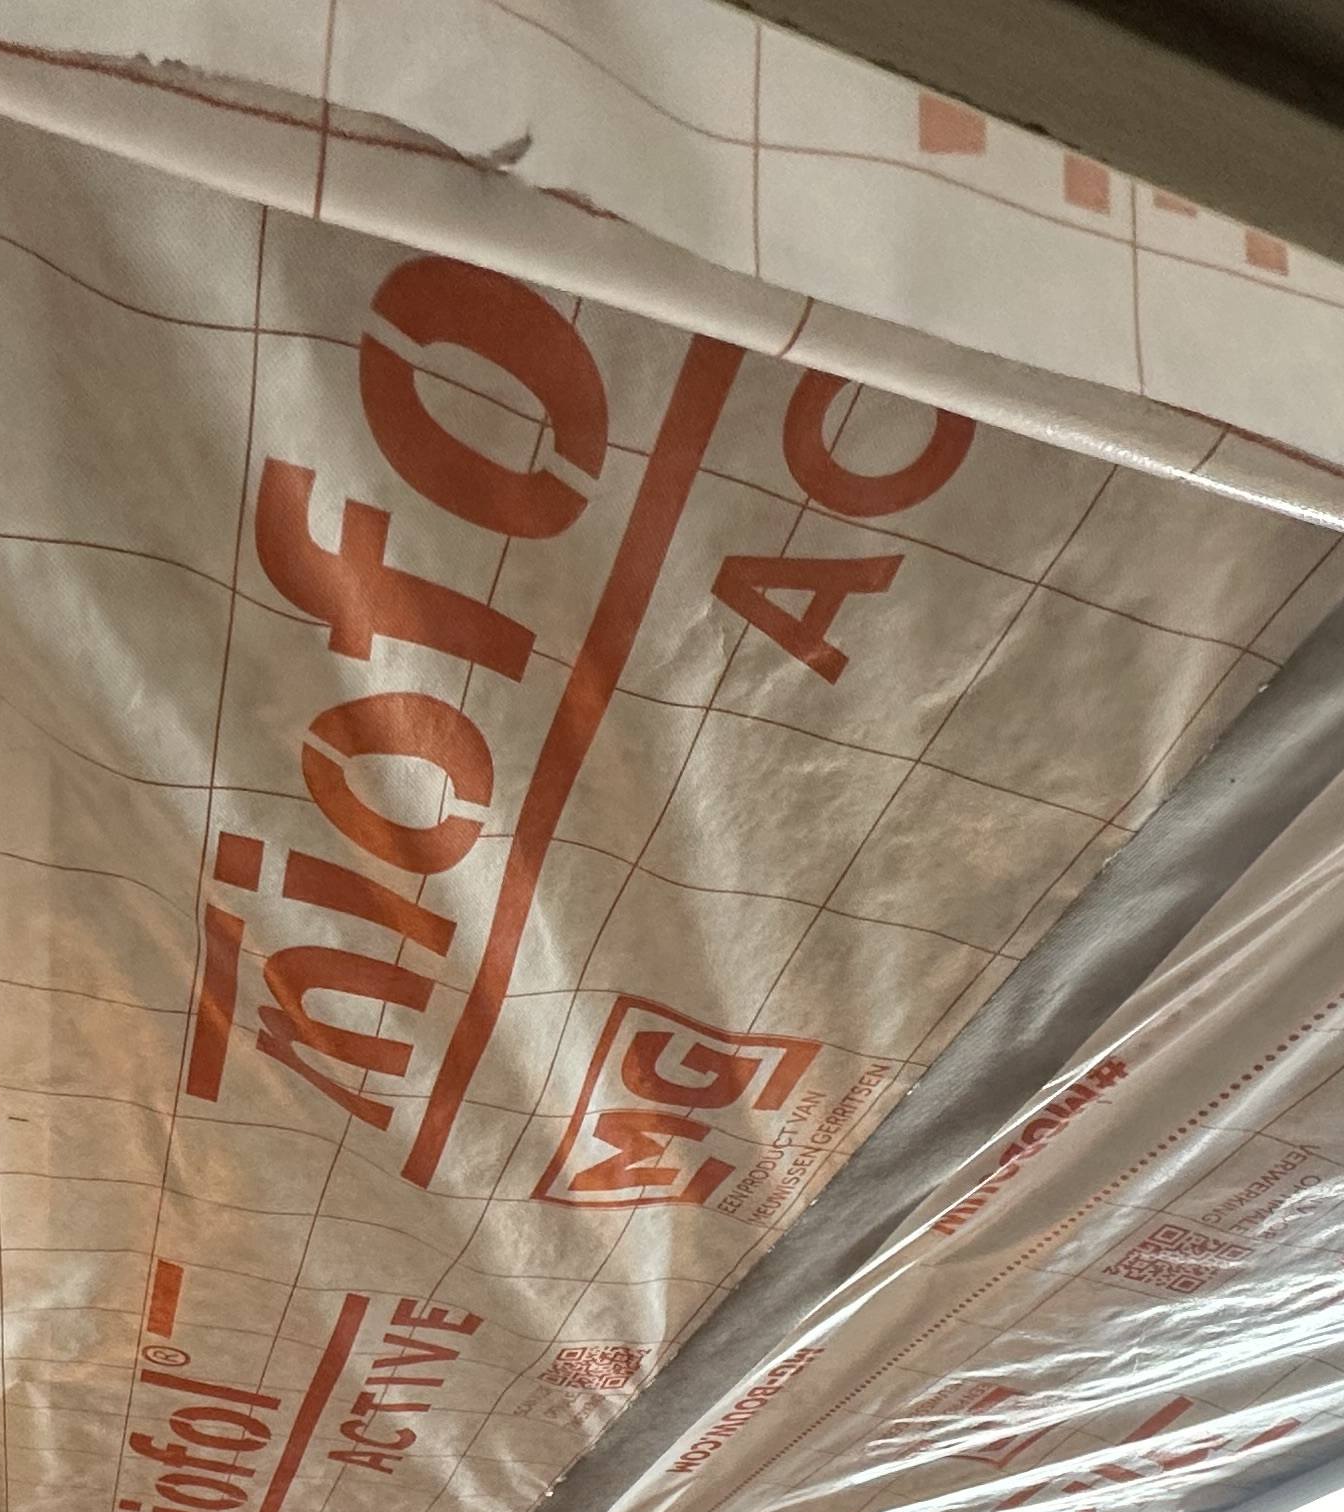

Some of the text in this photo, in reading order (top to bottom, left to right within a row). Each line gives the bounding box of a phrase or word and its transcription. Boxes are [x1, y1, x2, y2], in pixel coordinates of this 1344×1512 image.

[567, 1030, 763, 1194] MG
[787, 1090, 827, 1125] VAN
[811, 1063, 892, 1146] GERRITSEN
[327, 1298, 485, 1474] ACTIVE
